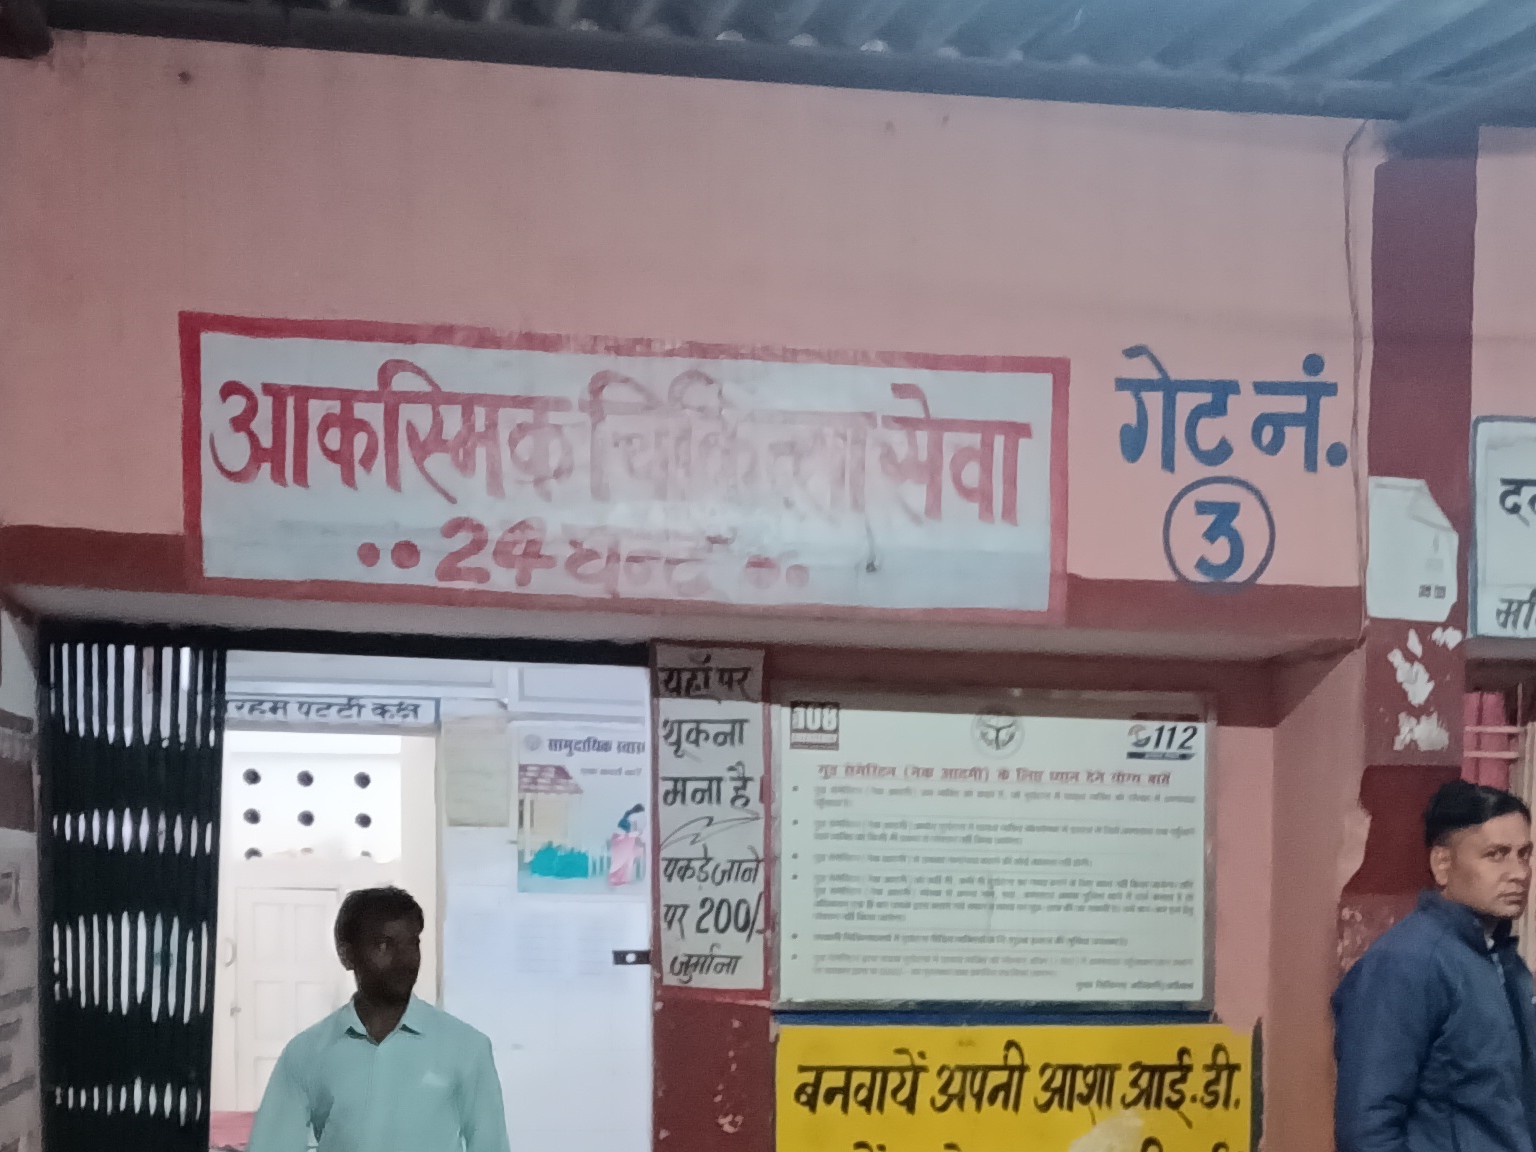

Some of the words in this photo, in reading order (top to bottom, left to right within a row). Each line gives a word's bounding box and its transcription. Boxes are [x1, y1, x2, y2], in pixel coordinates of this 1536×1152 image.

[1115, 345, 1241, 474] गेट
[1251, 353, 1348, 474] नं.
[210, 357, 574, 504] आकस्मिक
[879, 383, 1032, 527] सेवा
[434, 514, 558, 587] 24
[1194, 500, 1245, 581] 3
[715, 667, 752, 700] पर
[662, 718, 750, 759] थूकना
[1153, 724, 1199, 751] 112
[661, 775, 725, 806] मना
[727, 761, 755, 810] है
[710, 845, 765, 887] जाने
[662, 904, 691, 942] पर
[794, 1047, 928, 1114] बनवायें
[930, 1040, 1031, 1114] अपनी
